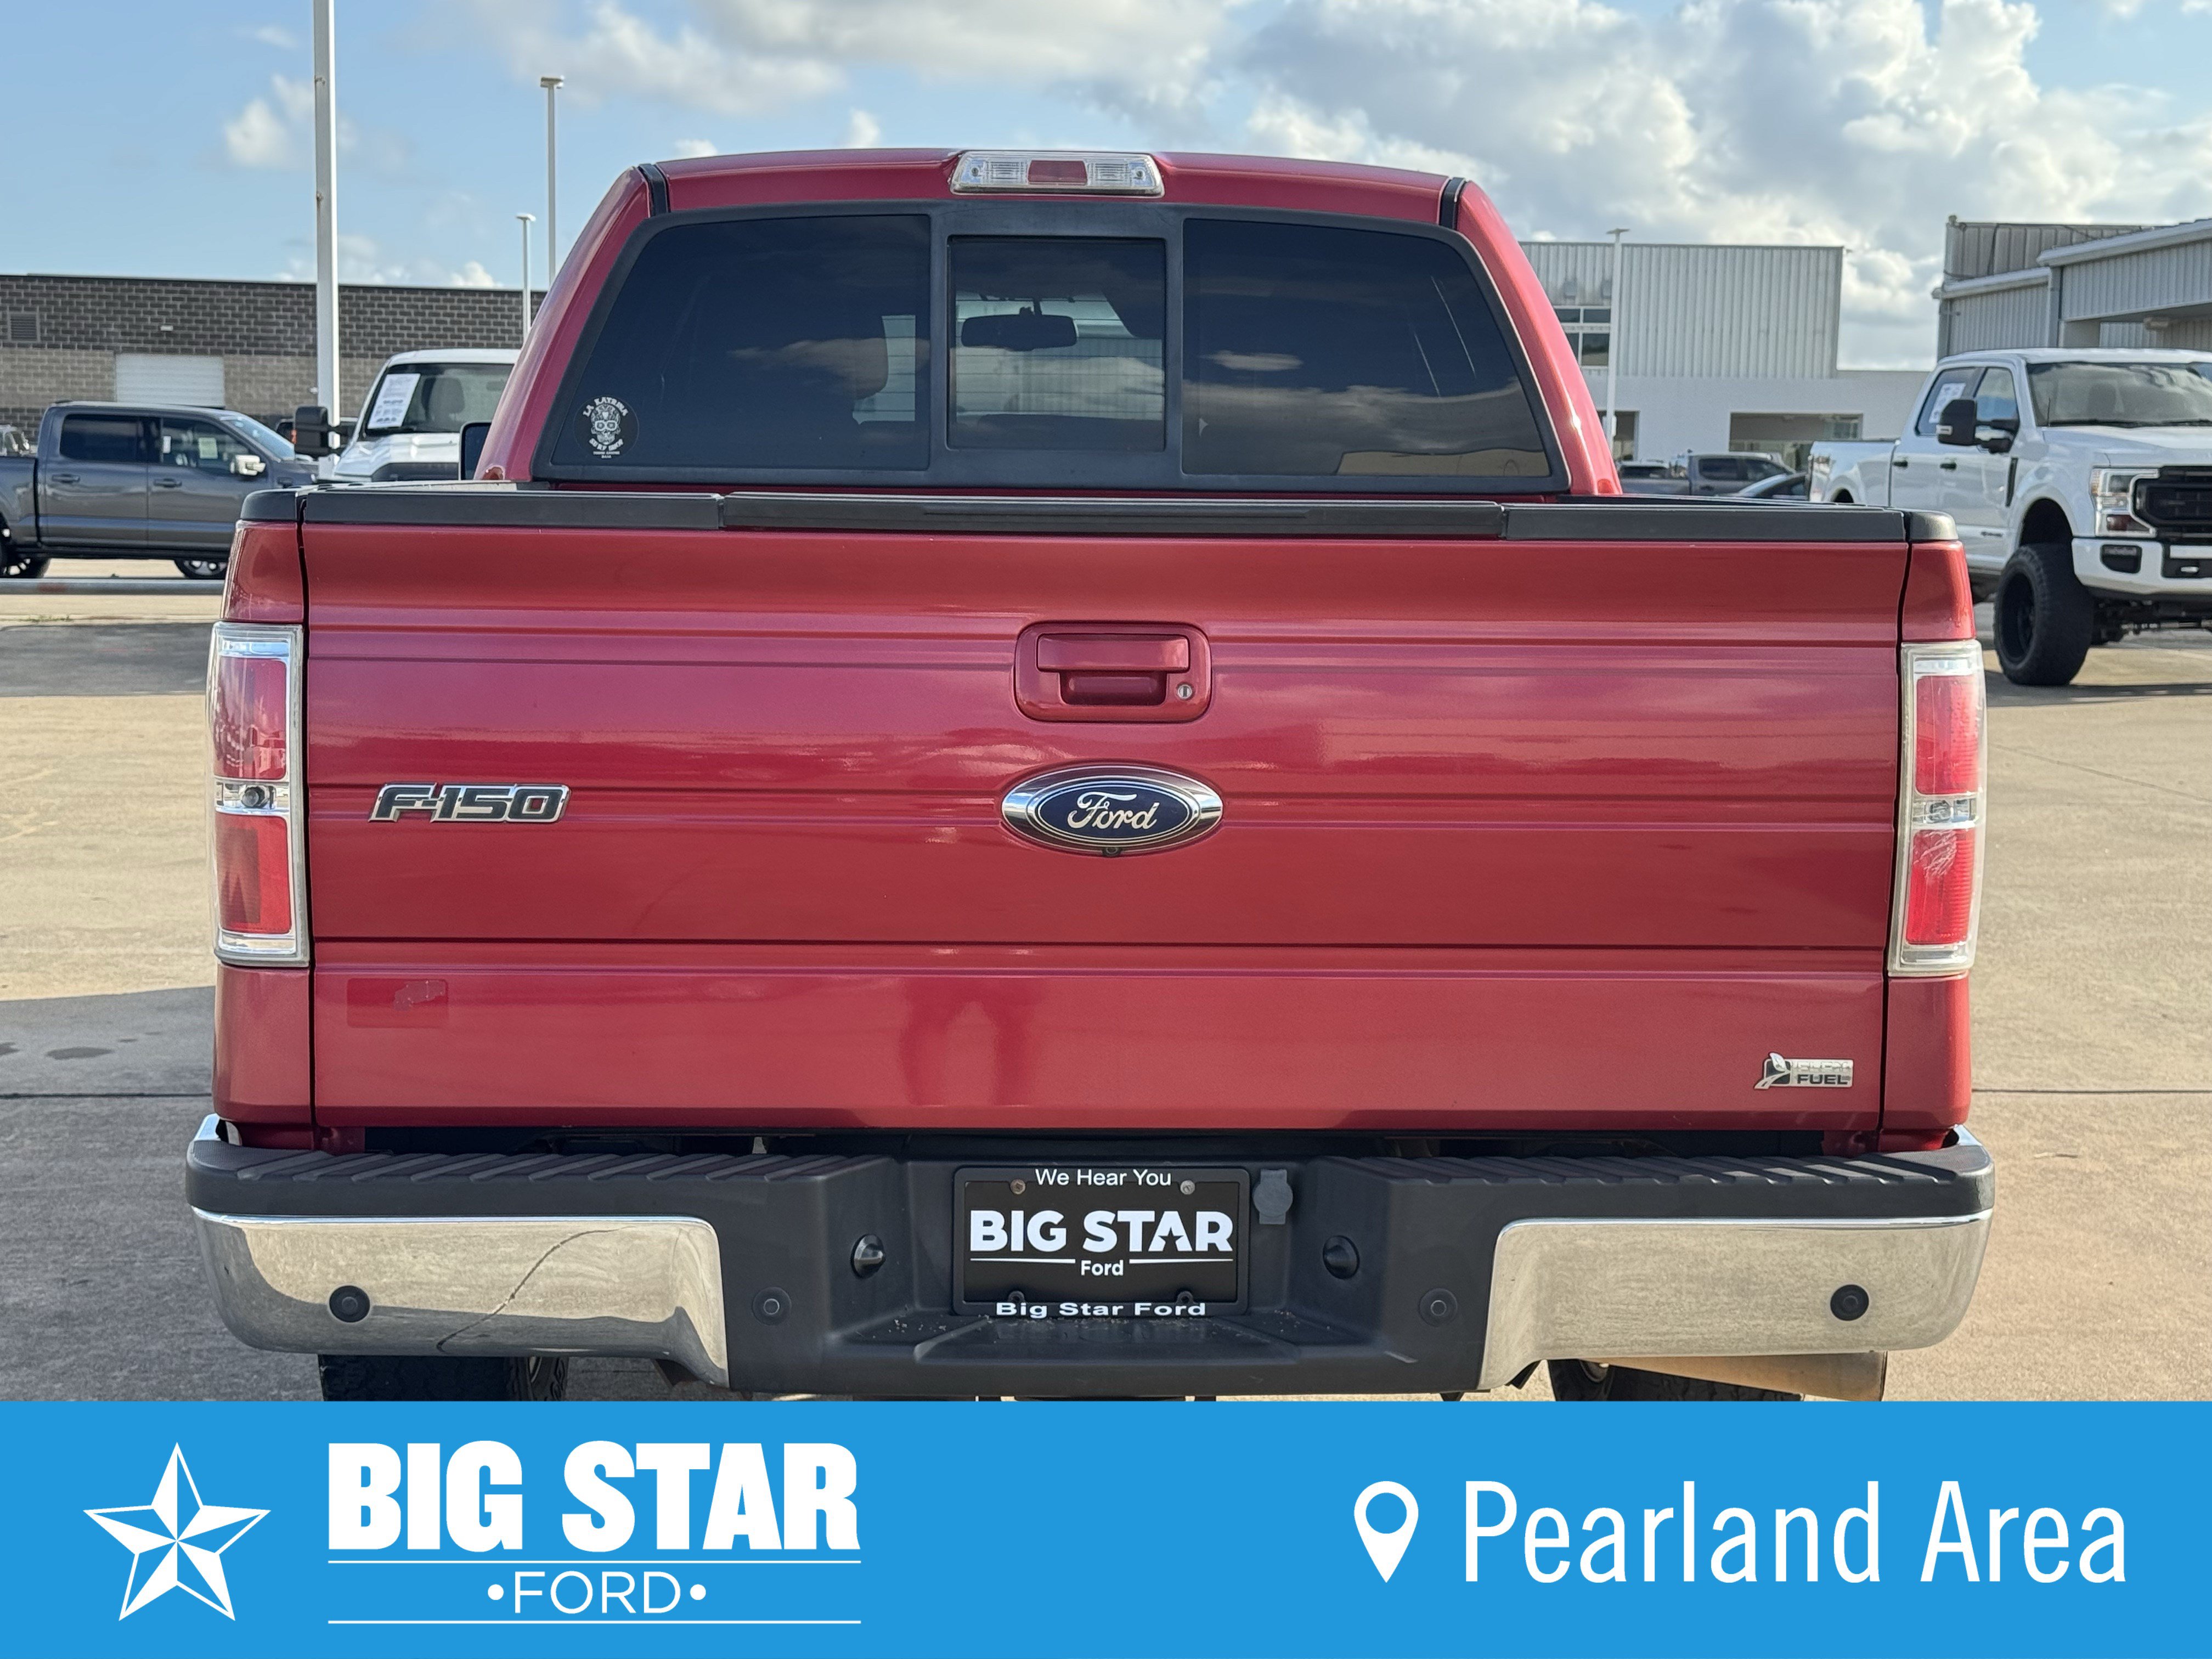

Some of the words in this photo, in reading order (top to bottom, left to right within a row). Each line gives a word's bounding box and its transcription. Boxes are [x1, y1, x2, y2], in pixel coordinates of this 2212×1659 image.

[583, 405, 594, 417] LA
[368, 782, 571, 822] F-150
[1068, 792, 1160, 829] Ford
[1797, 1074, 1848, 1085] FUEL
[1035, 1169, 1069, 1186] We
[1077, 1169, 1127, 1186] Hear
[1133, 1169, 1171, 1186] You
[970, 1210, 1066, 1252] BIG
[1082, 1210, 1233, 1252] STAR
[1081, 1260, 1124, 1276] Ford
[996, 1302, 1047, 1318] Big
[1059, 1302, 1124, 1316] Star
[1135, 1302, 1206, 1316] Ford
